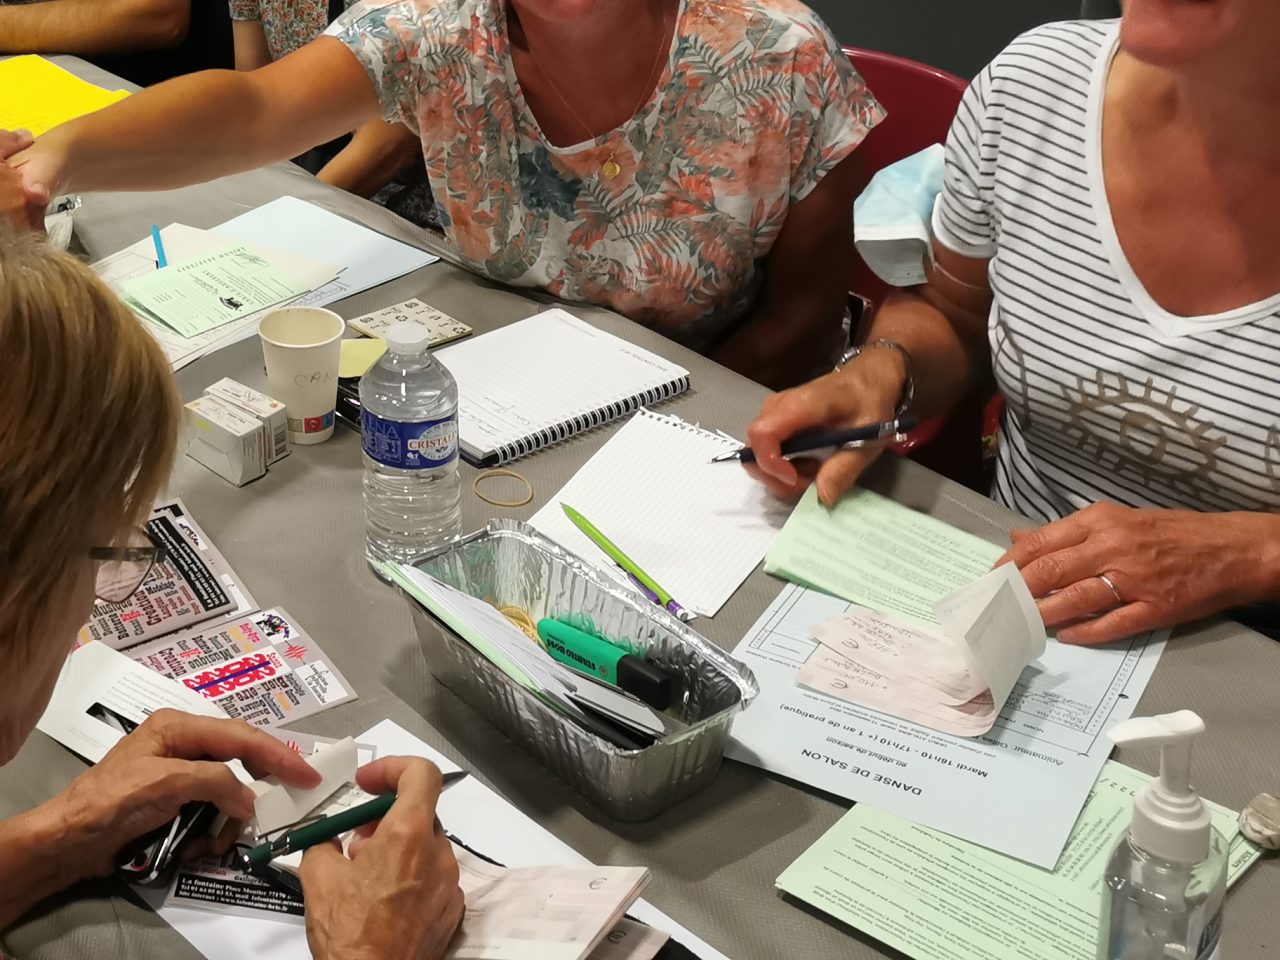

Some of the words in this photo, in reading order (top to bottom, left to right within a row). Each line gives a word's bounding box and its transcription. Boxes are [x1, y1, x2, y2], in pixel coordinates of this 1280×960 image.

[188, 649, 234, 668] Musique
[219, 696, 242, 718] Piano
[779, 703, 826, 725] pratique)
[880, 737, 911, 754] 17h10
[801, 748, 848, 771] SALON
[922, 751, 954, 769] 16h10
[850, 765, 870, 779] DE
[958, 764, 988, 778] Mardi
[873, 773, 923, 796] DANSE
[193, 878, 225, 890] fontaine
